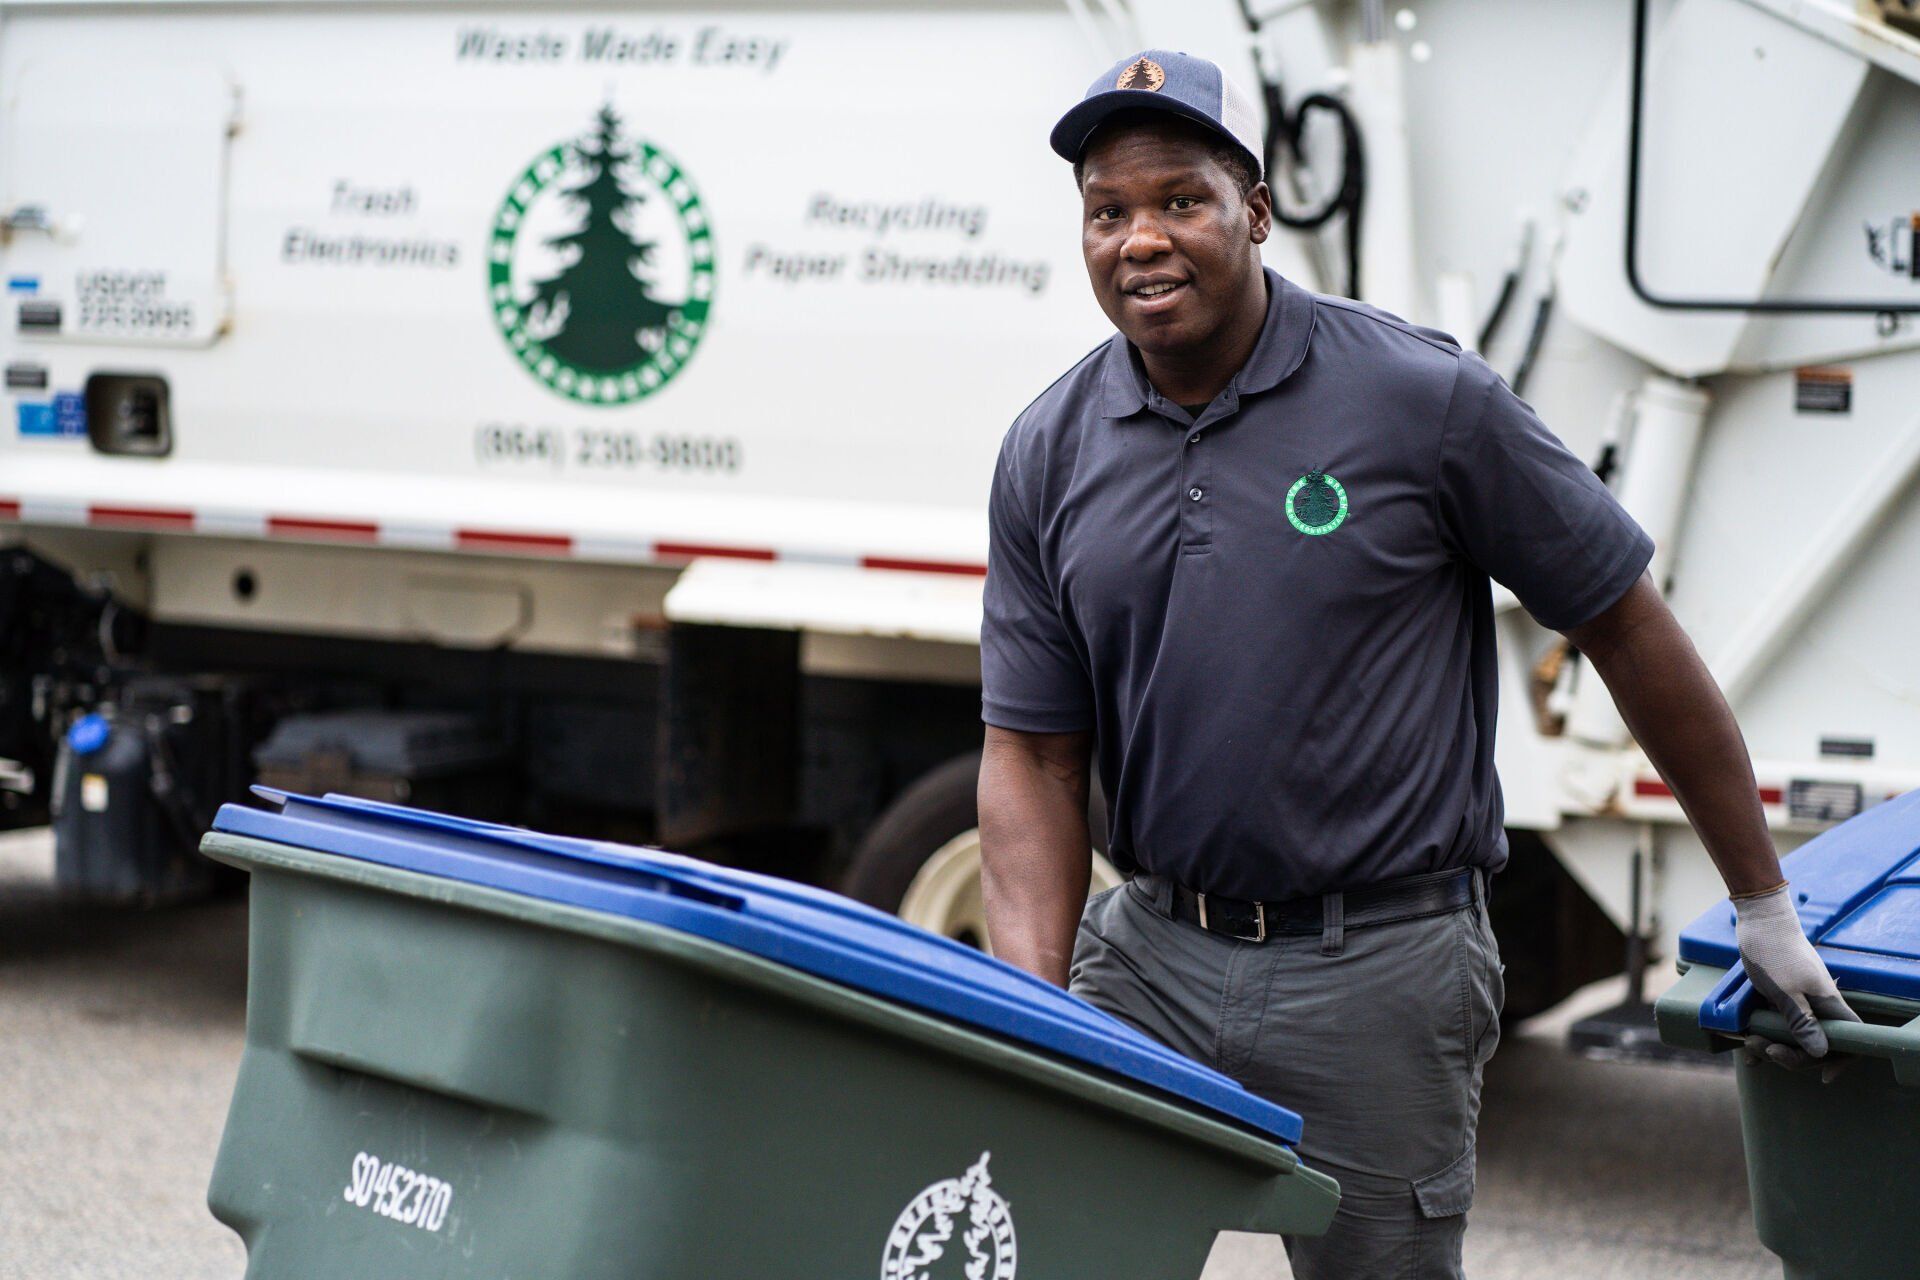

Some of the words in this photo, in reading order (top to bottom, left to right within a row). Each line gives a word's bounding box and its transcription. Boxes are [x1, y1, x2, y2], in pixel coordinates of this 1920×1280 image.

[456, 26, 567, 62] Waste
[580, 26, 679, 63] Made
[690, 25, 787, 72] Easy
[332, 179, 417, 217] Trash
[806, 193, 988, 242] Recycling
[281, 226, 460, 267] Electronics
[744, 244, 847, 284] Paper
[861, 247, 1052, 297] Shredding
